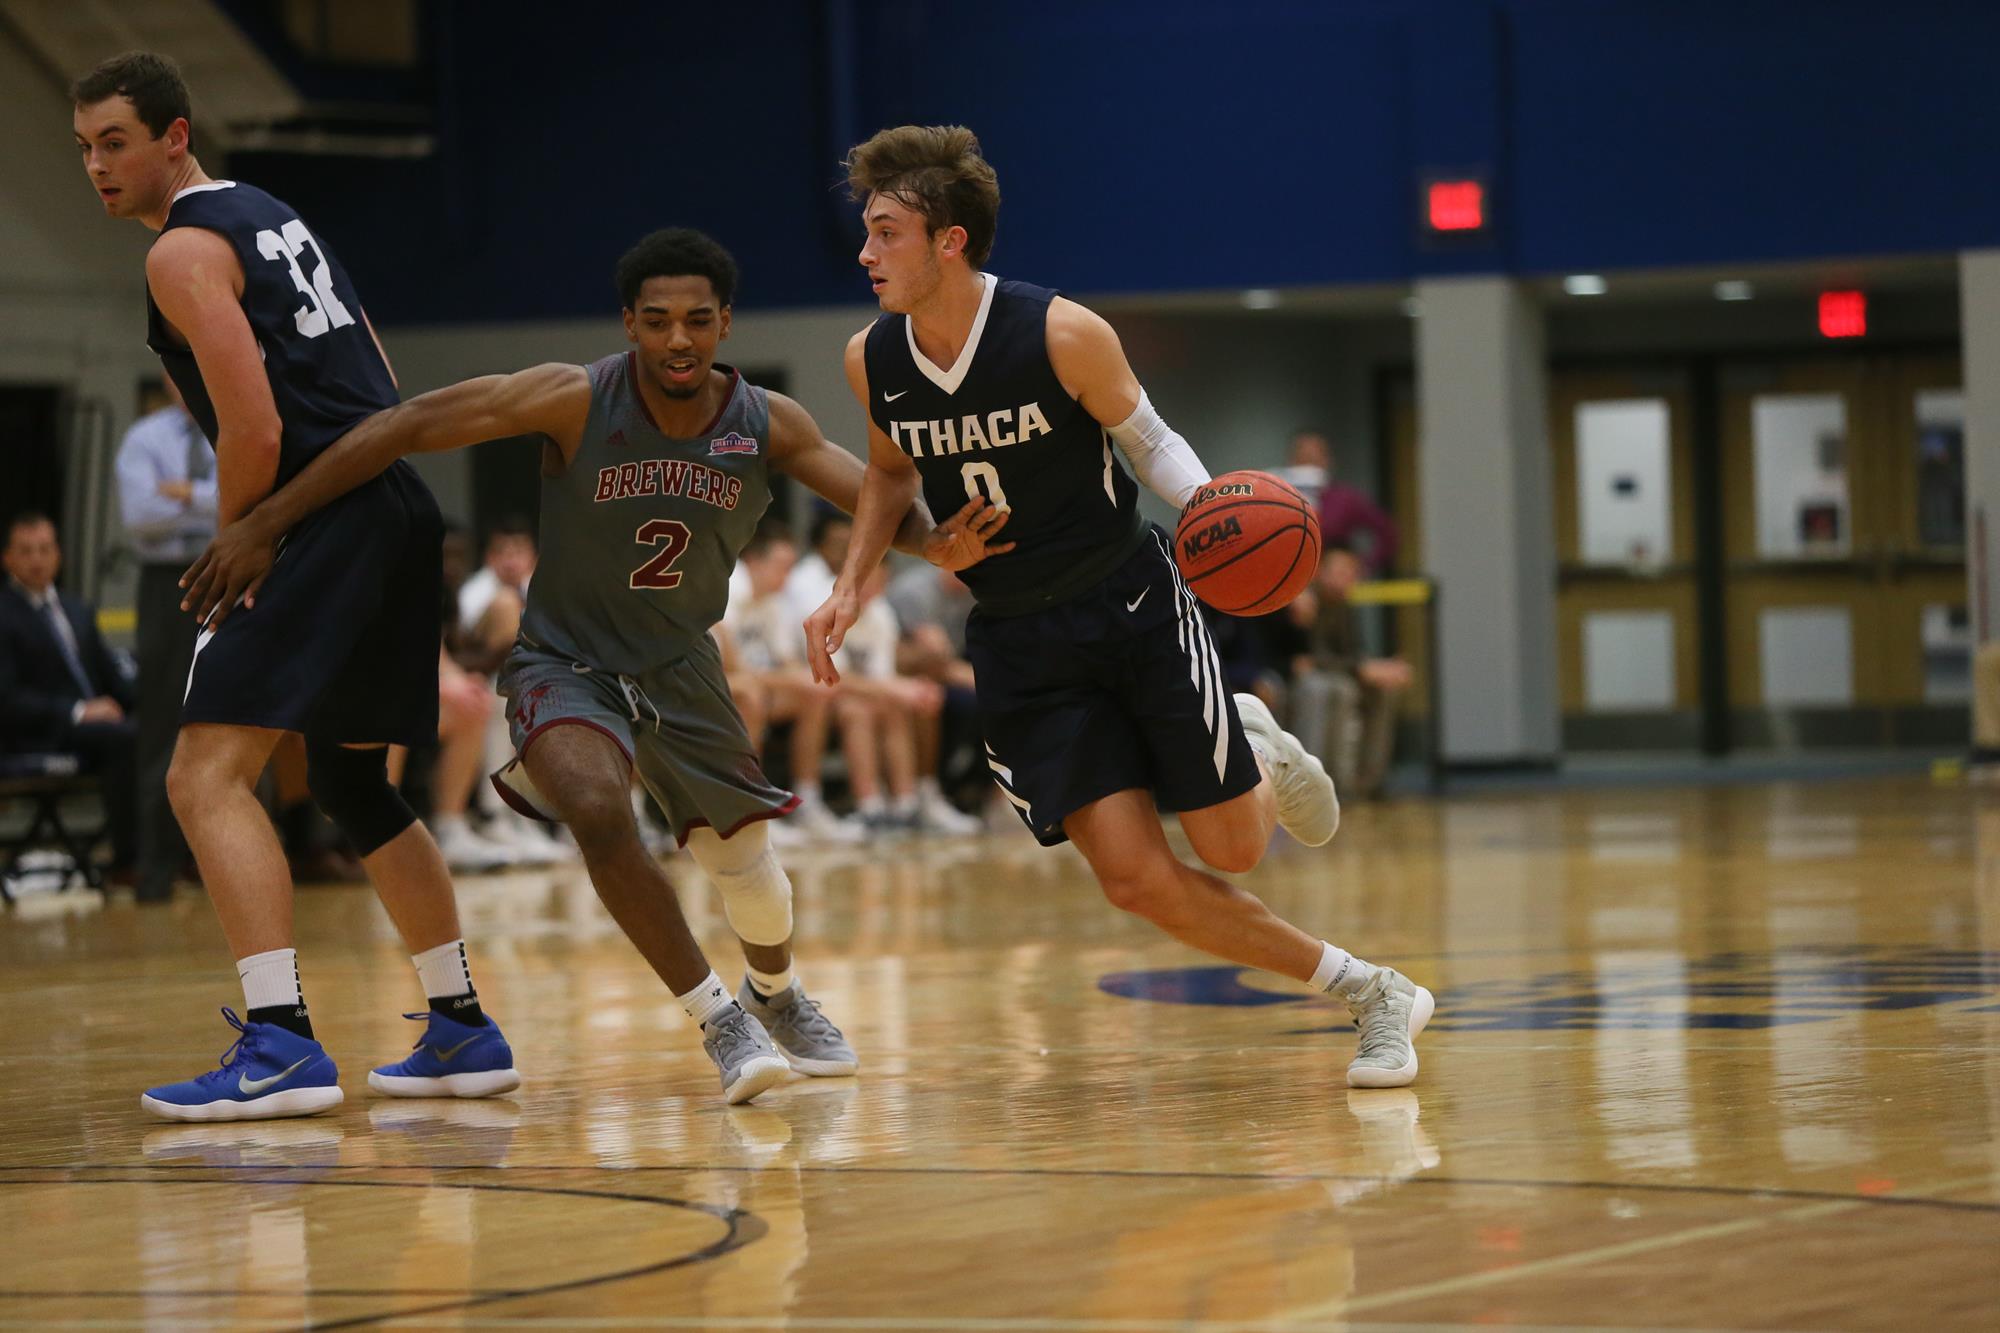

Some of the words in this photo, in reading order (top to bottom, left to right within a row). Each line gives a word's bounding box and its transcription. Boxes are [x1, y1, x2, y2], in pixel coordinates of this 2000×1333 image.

[256, 218, 356, 339] 32
[890, 401, 1053, 458] ITHACA
[594, 459, 742, 510] BREWERS
[960, 461, 1012, 522] 0
[629, 518, 692, 590] 2
[1183, 515, 1243, 562] NCAA
